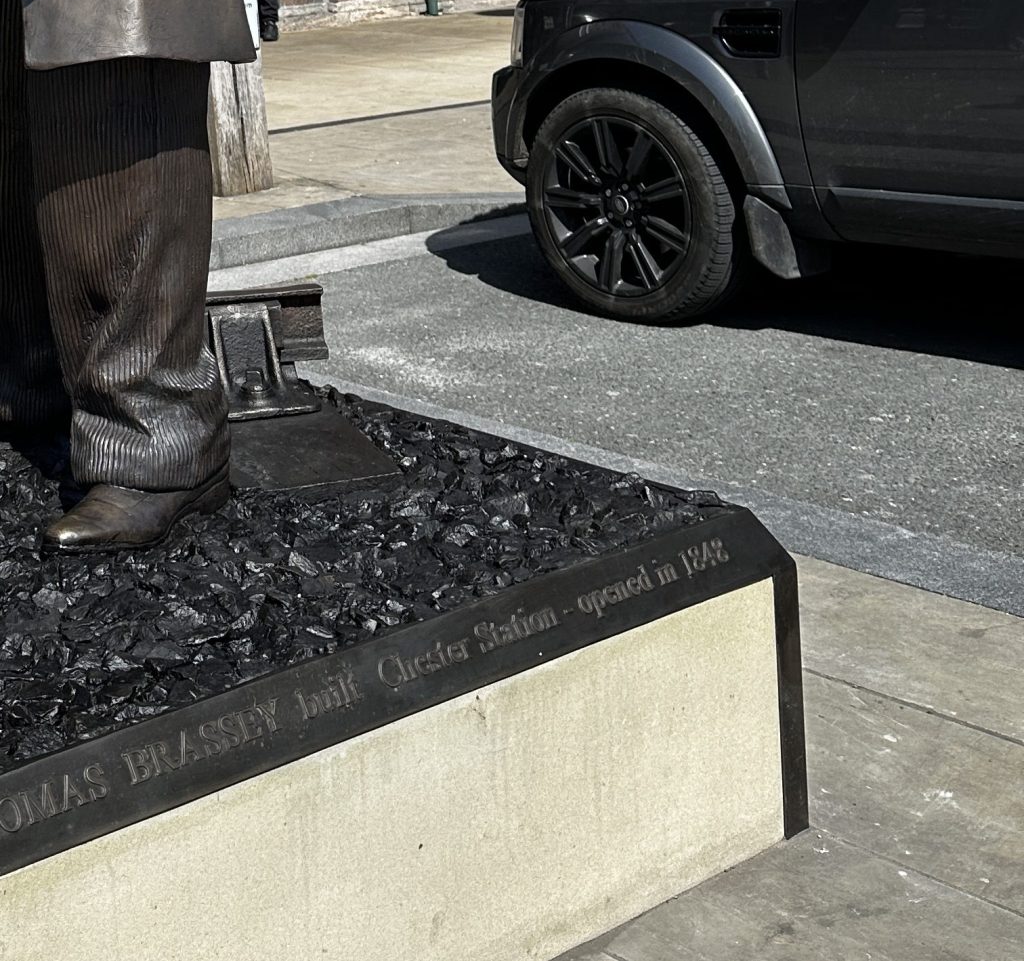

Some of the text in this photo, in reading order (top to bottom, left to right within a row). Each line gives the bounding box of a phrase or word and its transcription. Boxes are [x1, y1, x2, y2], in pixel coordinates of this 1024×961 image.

[121, 697, 281, 786] BRASSEY
[294, 671, 363, 720] built
[378, 639, 472, 688] Chester
[473, 606, 560, 654] Station
[577, 564, 655, 619] opened
[651, 559, 680, 586] in
[679, 538, 730, 580] 1848
